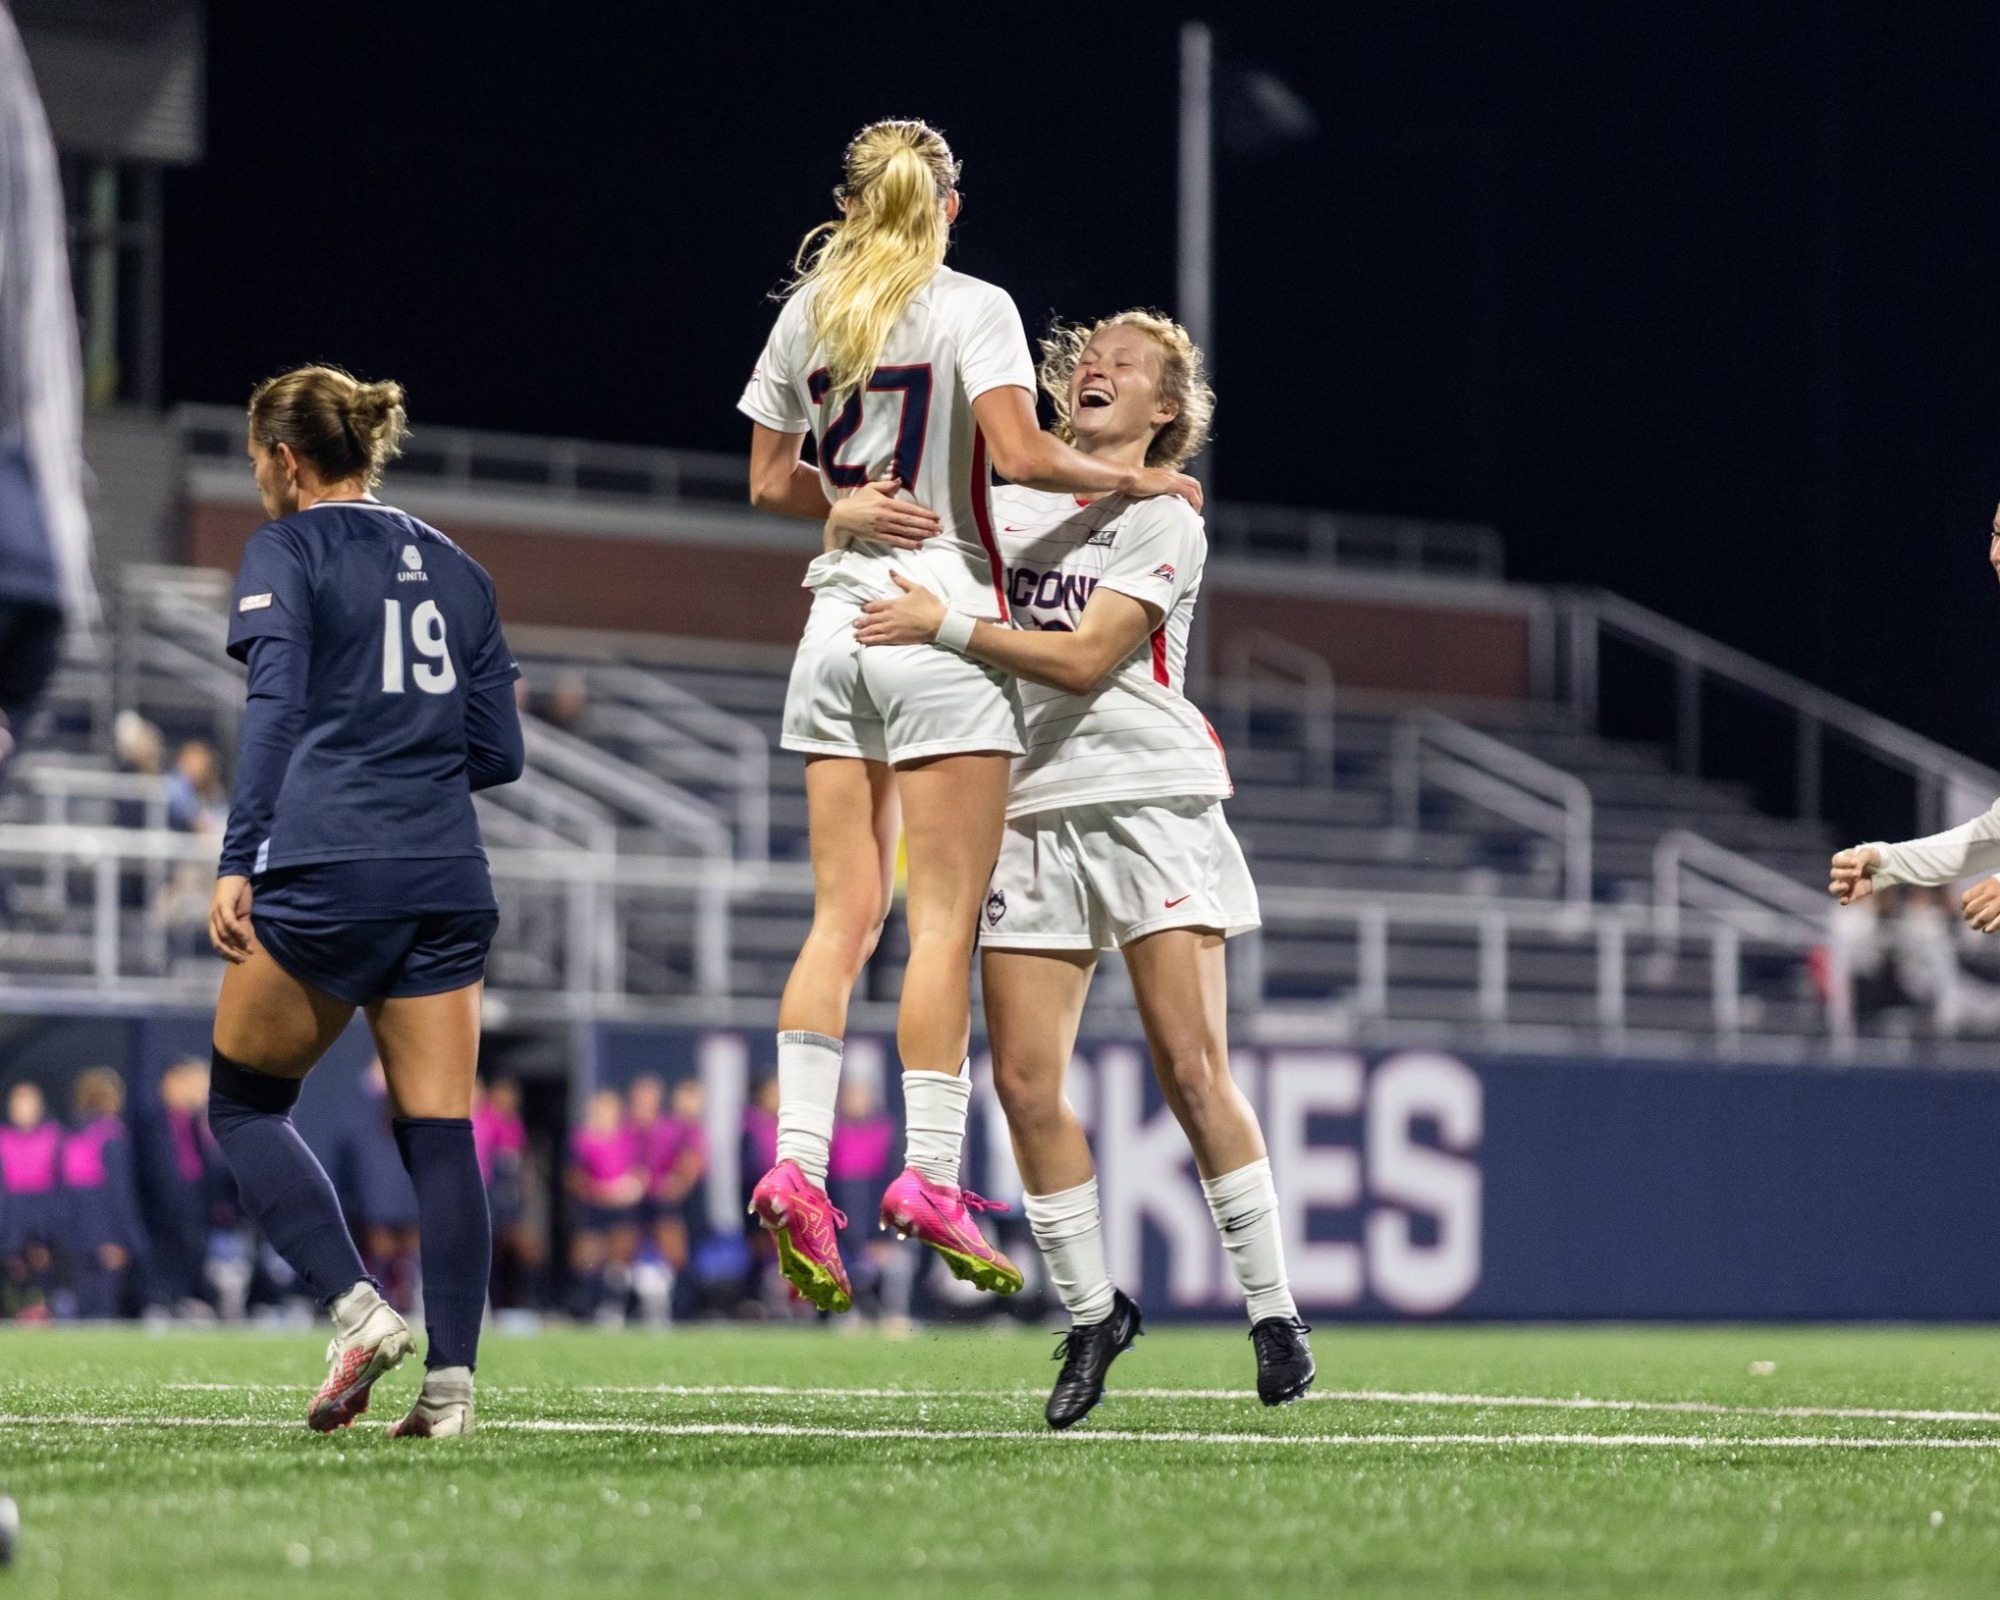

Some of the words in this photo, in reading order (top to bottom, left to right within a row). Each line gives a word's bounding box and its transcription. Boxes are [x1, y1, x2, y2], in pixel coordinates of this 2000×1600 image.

[807, 362, 933, 491] 27
[397, 571, 429, 582] UNITA
[381, 598, 458, 695] 19
